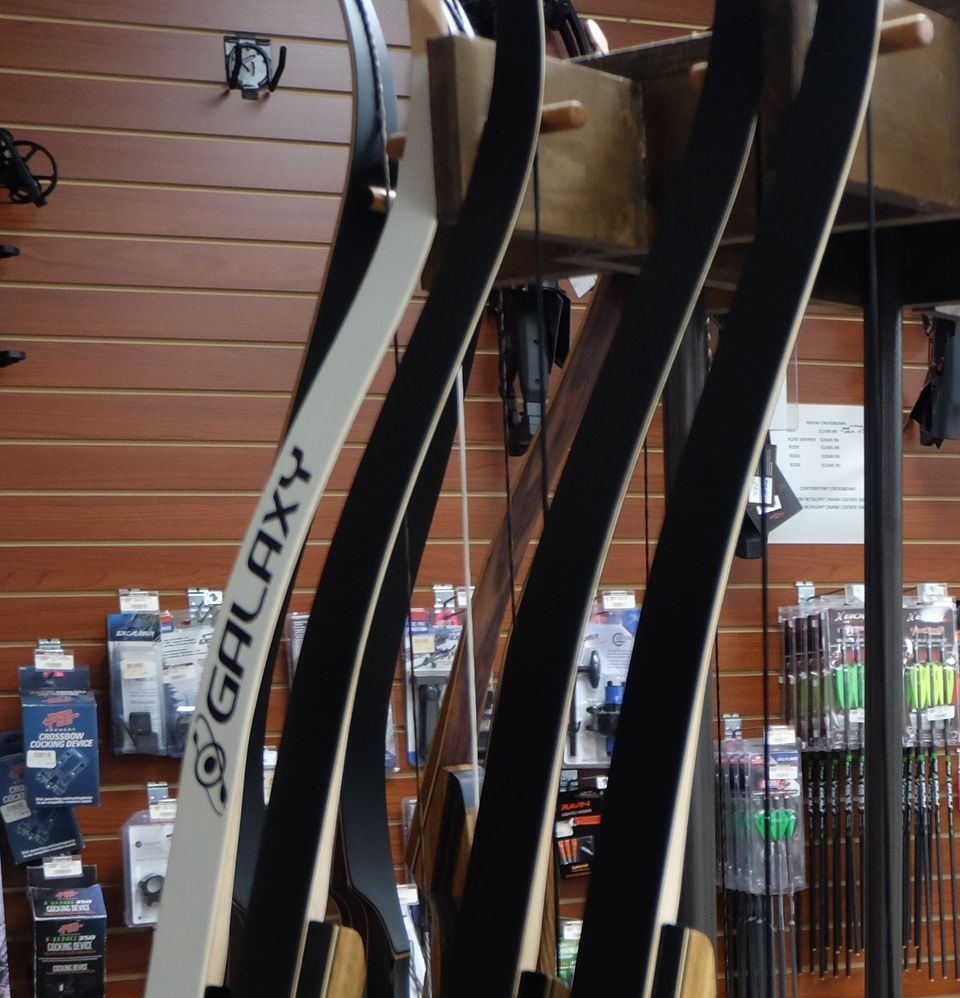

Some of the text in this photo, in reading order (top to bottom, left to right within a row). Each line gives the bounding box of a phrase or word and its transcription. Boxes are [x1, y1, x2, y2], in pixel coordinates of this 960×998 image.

[207, 446, 312, 724] GALAXY
[38, 732, 84, 741] CROSSBOW
[30, 739, 94, 749] COCKING DEVICE
[561, 800, 591, 811] RAVIN
[46, 903, 91, 913] COCKING DEVICE
[47, 940, 92, 952] COCKING DEVICE
